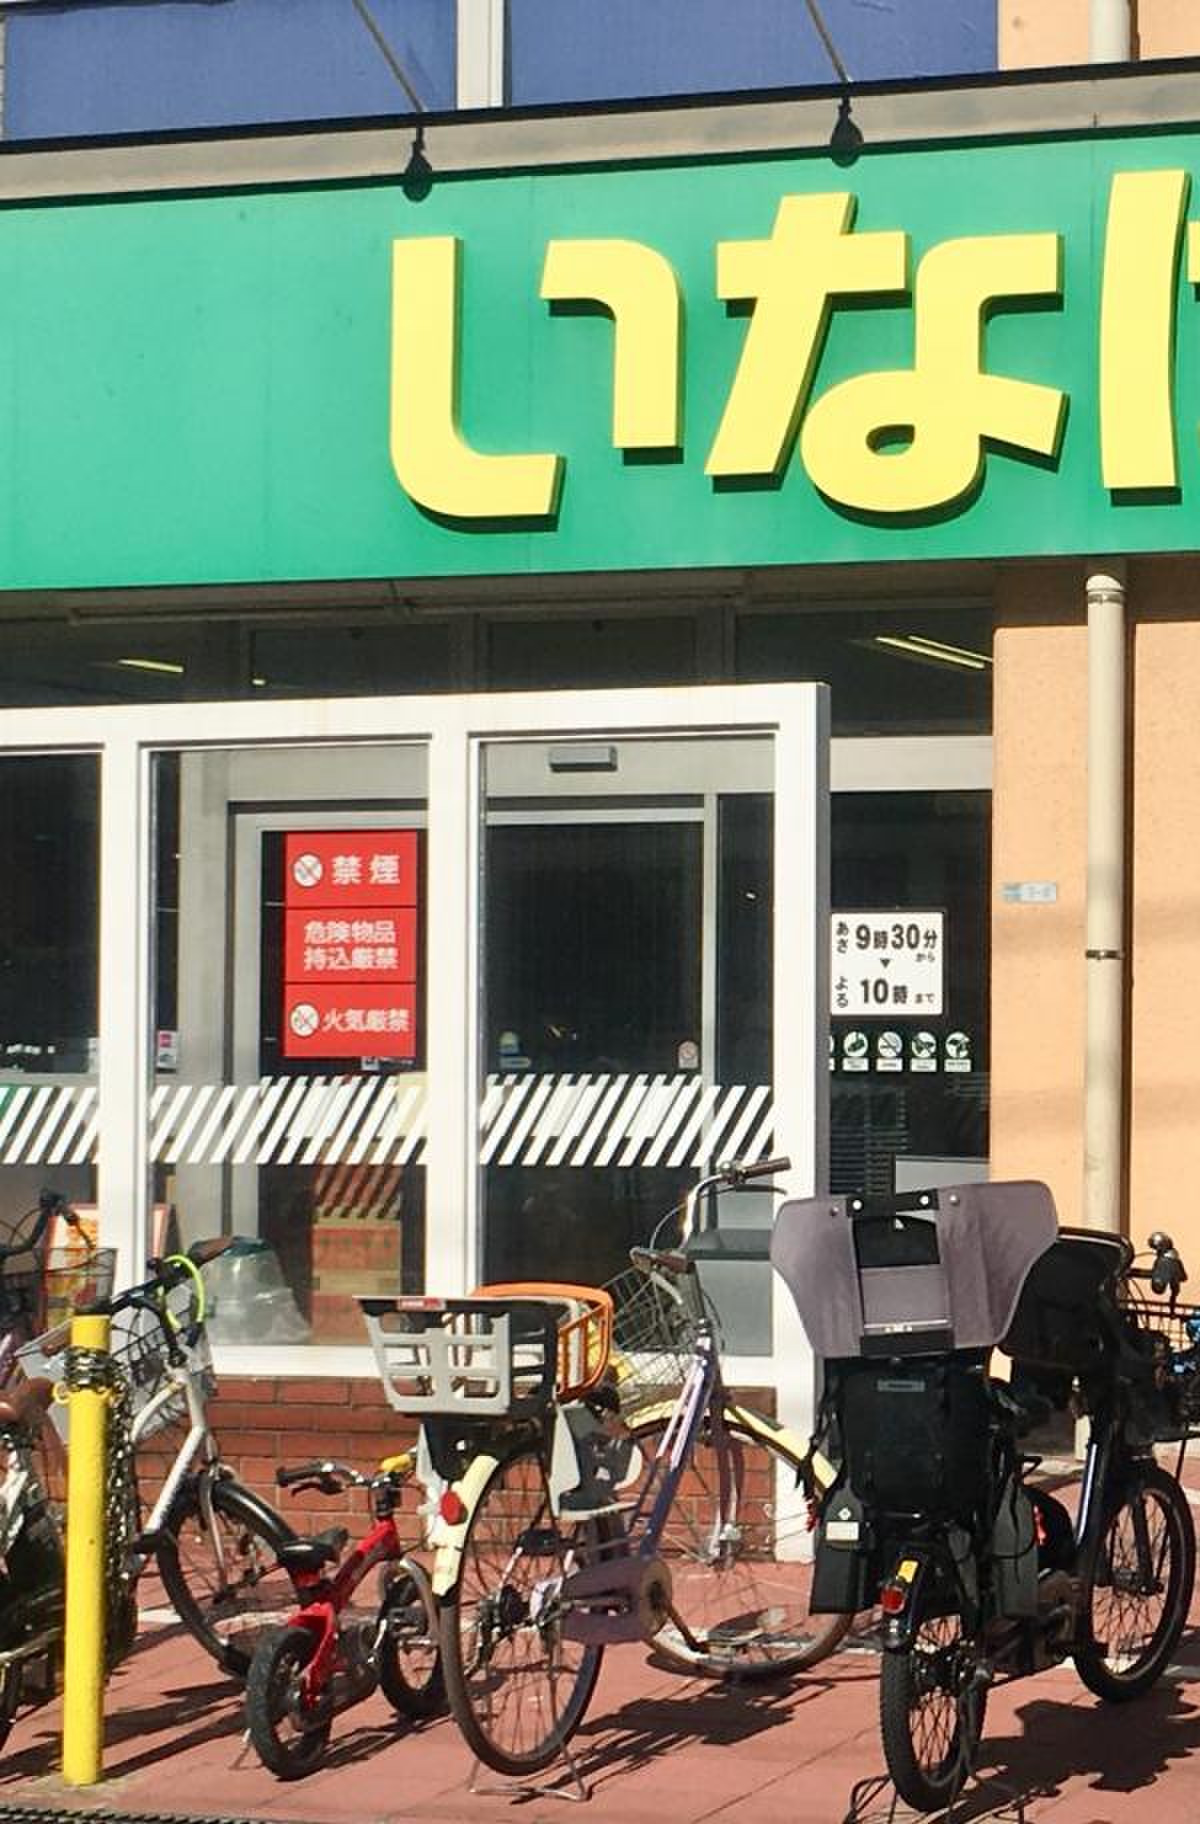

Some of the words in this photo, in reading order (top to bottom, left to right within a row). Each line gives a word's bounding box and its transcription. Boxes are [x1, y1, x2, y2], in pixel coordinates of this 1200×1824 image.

[331, 855, 401, 886] 禁煙
[303, 920, 397, 944] 危険物品
[836, 922, 849, 954] あさ
[855, 924, 938, 950] 9時30分
[303, 947, 399, 971] 持込厳禁
[835, 976, 849, 1009] よる
[860, 979, 908, 1005] 10時
[322, 1009, 410, 1032] 火気厳禁
